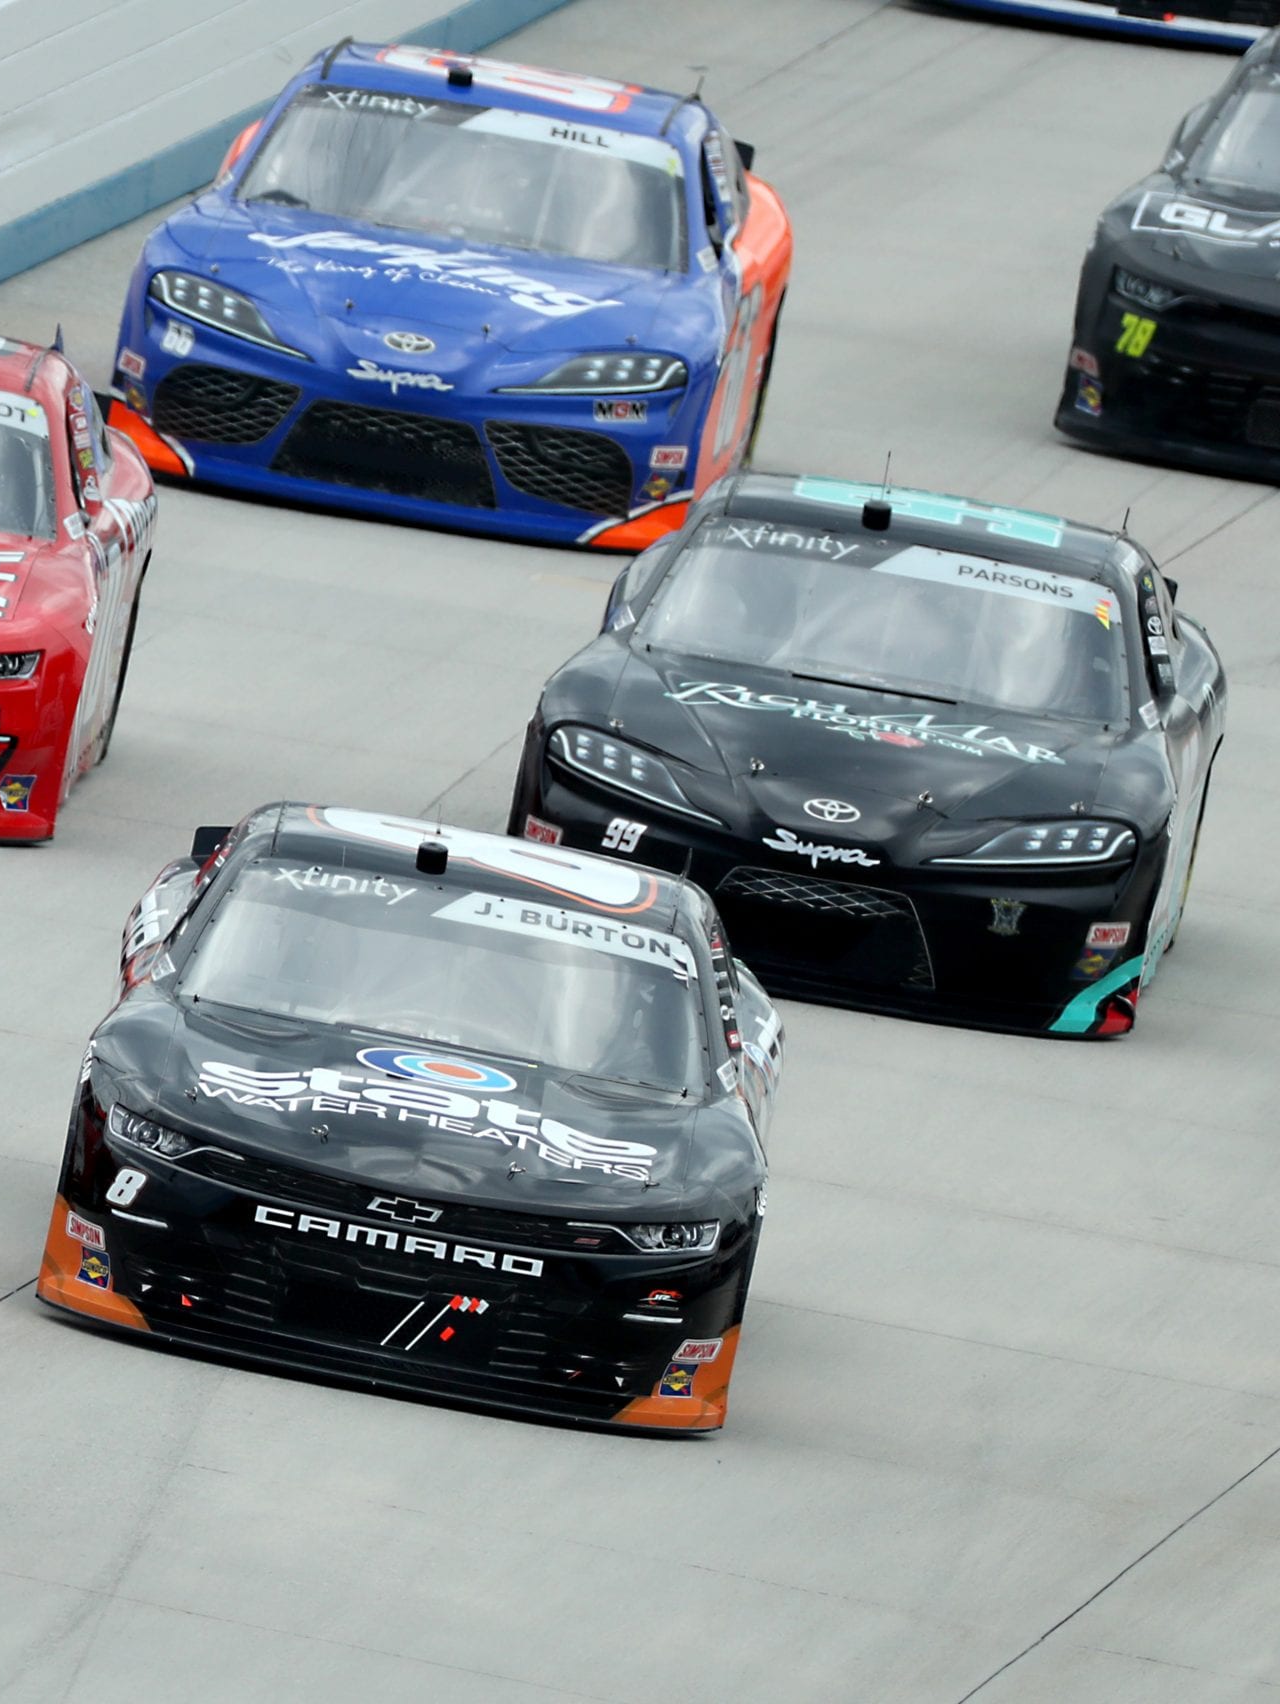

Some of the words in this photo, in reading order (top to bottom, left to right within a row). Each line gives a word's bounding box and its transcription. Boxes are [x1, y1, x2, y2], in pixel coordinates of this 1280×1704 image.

[321, 89, 440, 119] xfinity
[551, 126, 610, 148] HILL
[315, 260, 377, 279] King
[384, 267, 412, 283] of
[419, 271, 500, 296] Clean
[1116, 312, 1156, 356] 78
[346, 360, 454, 395] Supra
[723, 523, 861, 561] xfinity
[957, 565, 1074, 599] PARSONS
[601, 817, 648, 853] 99
[762, 828, 881, 868] Supra
[273, 866, 418, 905] xfinity
[474, 902, 504, 919] J.
[519, 909, 672, 957] BURTON
[1090, 926, 1127, 944] SIMPSON
[198, 1082, 387, 1119] WATER
[397, 1112, 650, 1182] HEATERS
[105, 1167, 147, 1205] 8
[69, 1216, 102, 1246] SIMPSON
[254, 1205, 544, 1277] CAMARO
[82, 1258, 109, 1276] SUNOCO
[677, 1342, 719, 1360] SIMPSON
